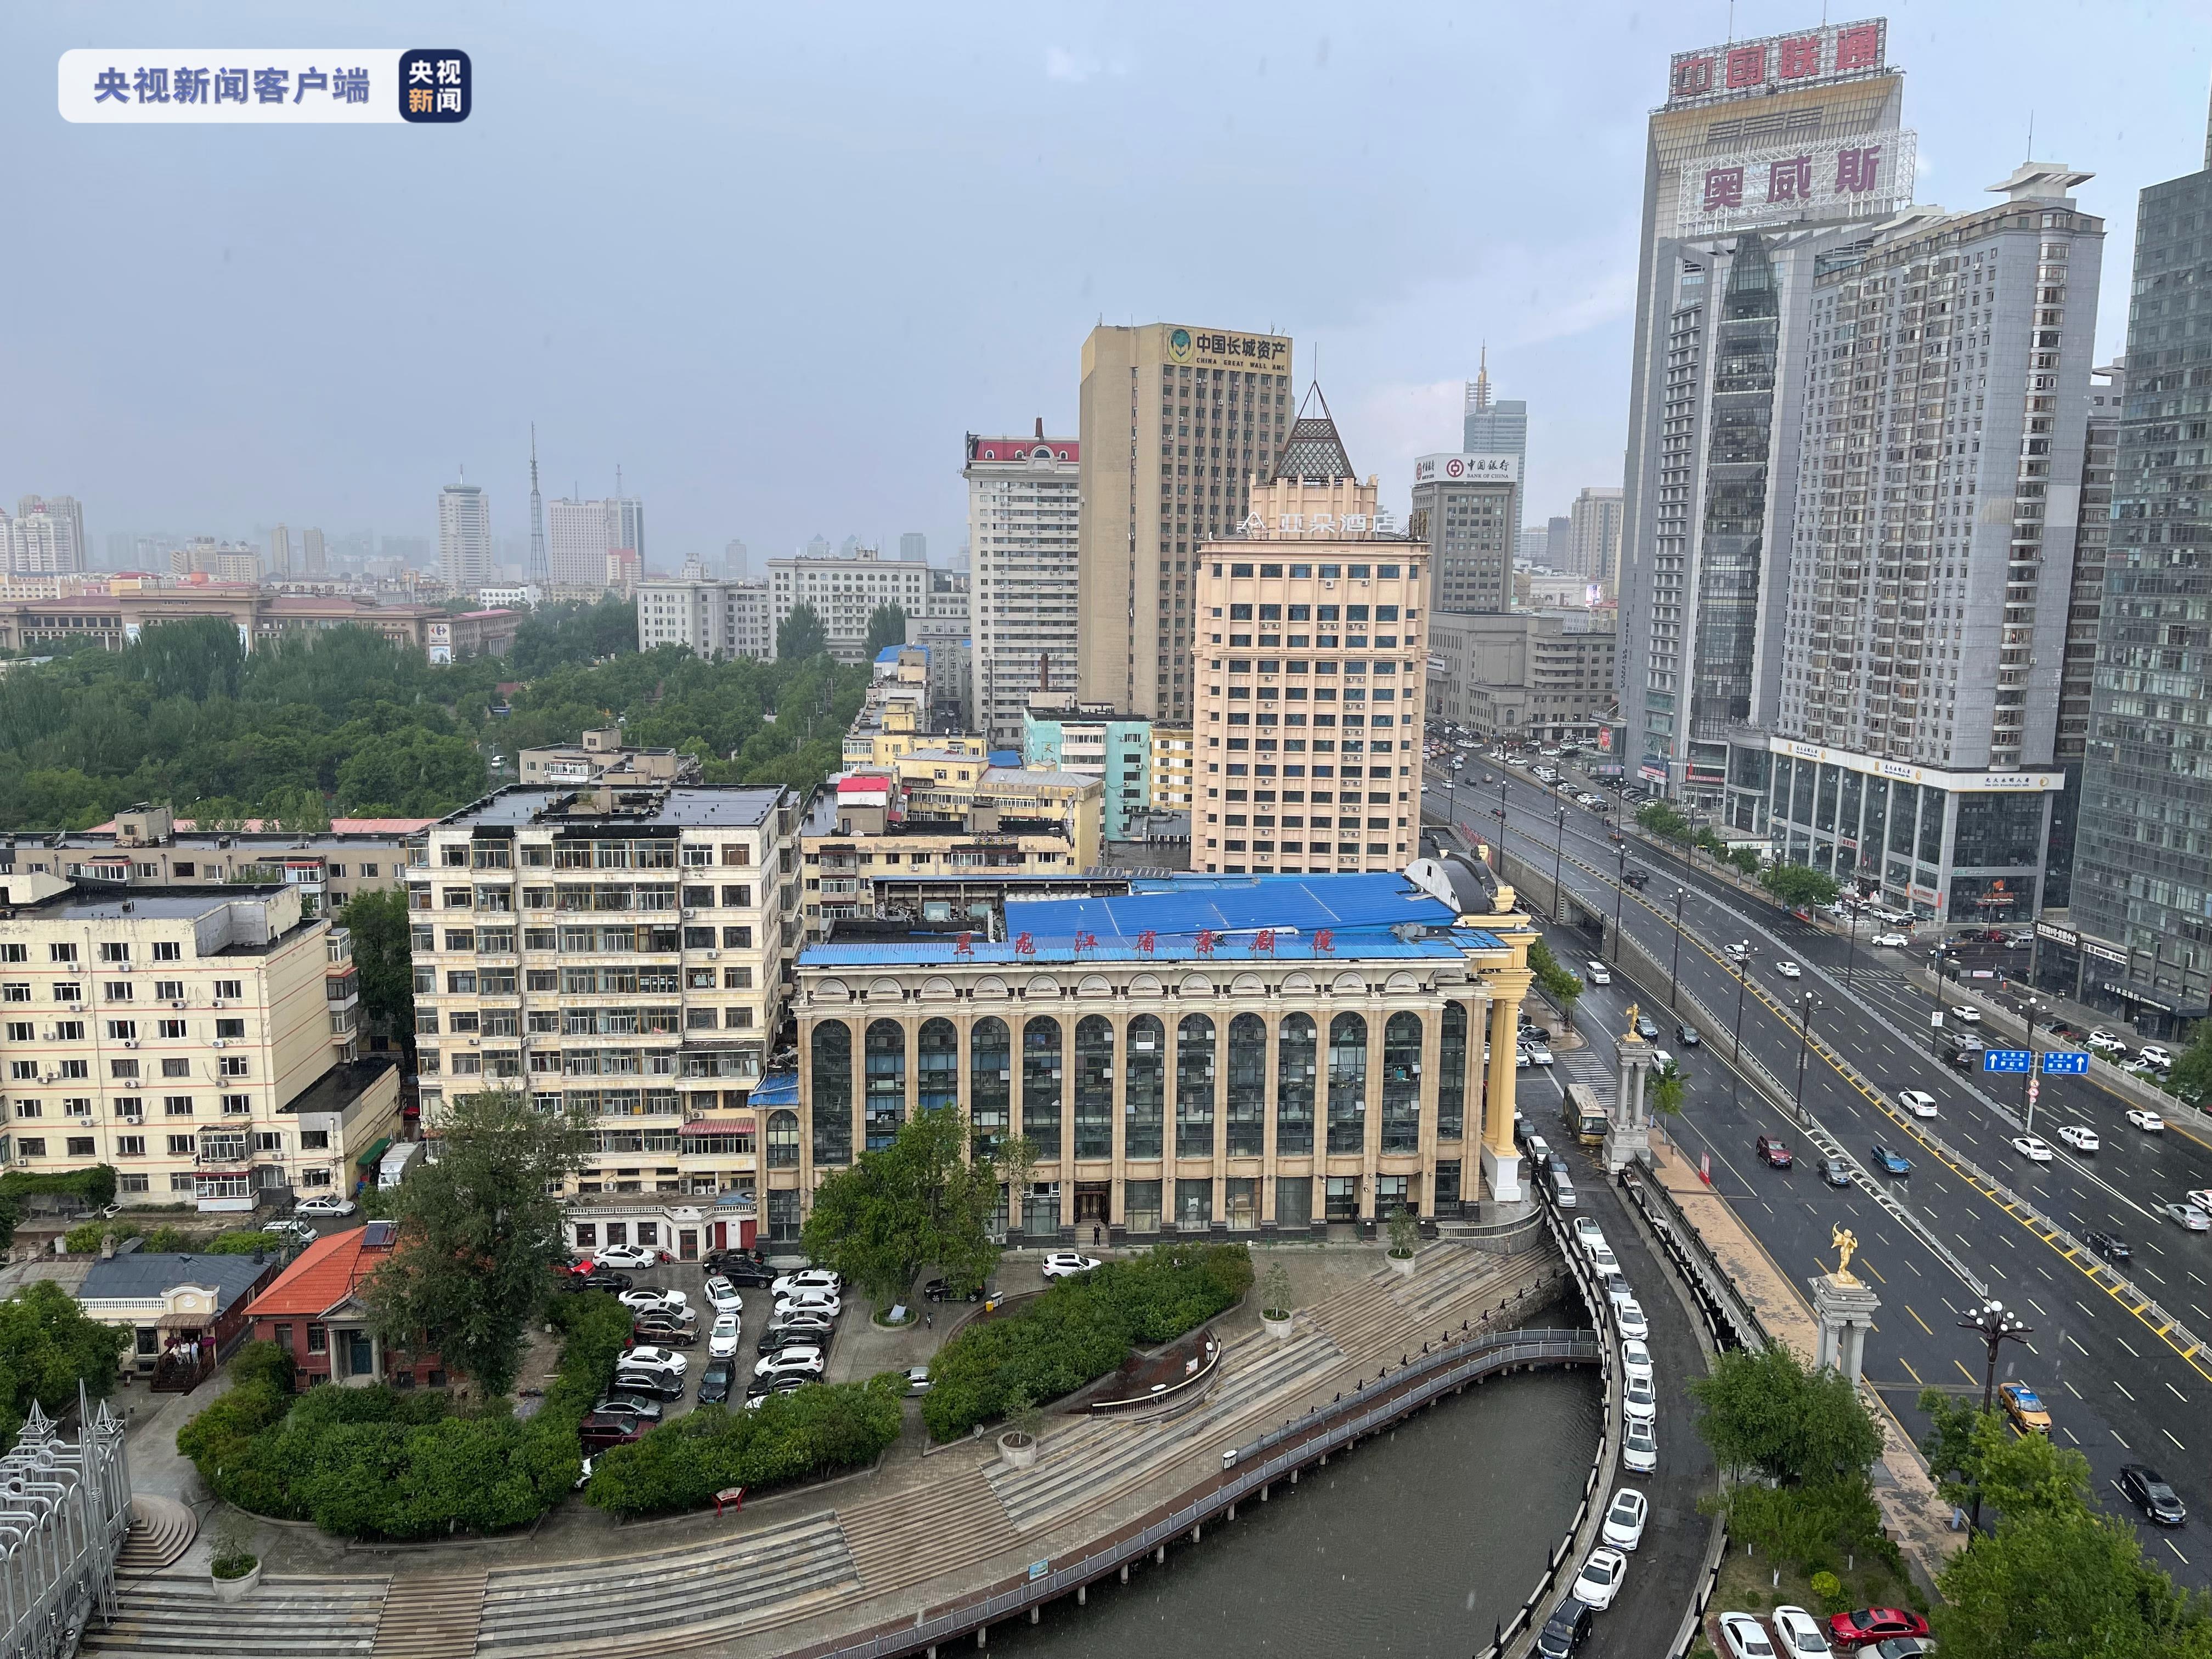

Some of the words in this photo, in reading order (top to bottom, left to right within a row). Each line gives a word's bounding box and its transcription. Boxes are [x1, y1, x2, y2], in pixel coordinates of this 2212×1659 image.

[1675, 24, 1878, 96] 中国联通
[1703, 144, 1882, 211] 奥威斯
[1197, 333, 1286, 360] 中国长城资产
[1467, 459, 1510, 471] 中国银行
[1278, 513, 1397, 533] 亚朵酒店
